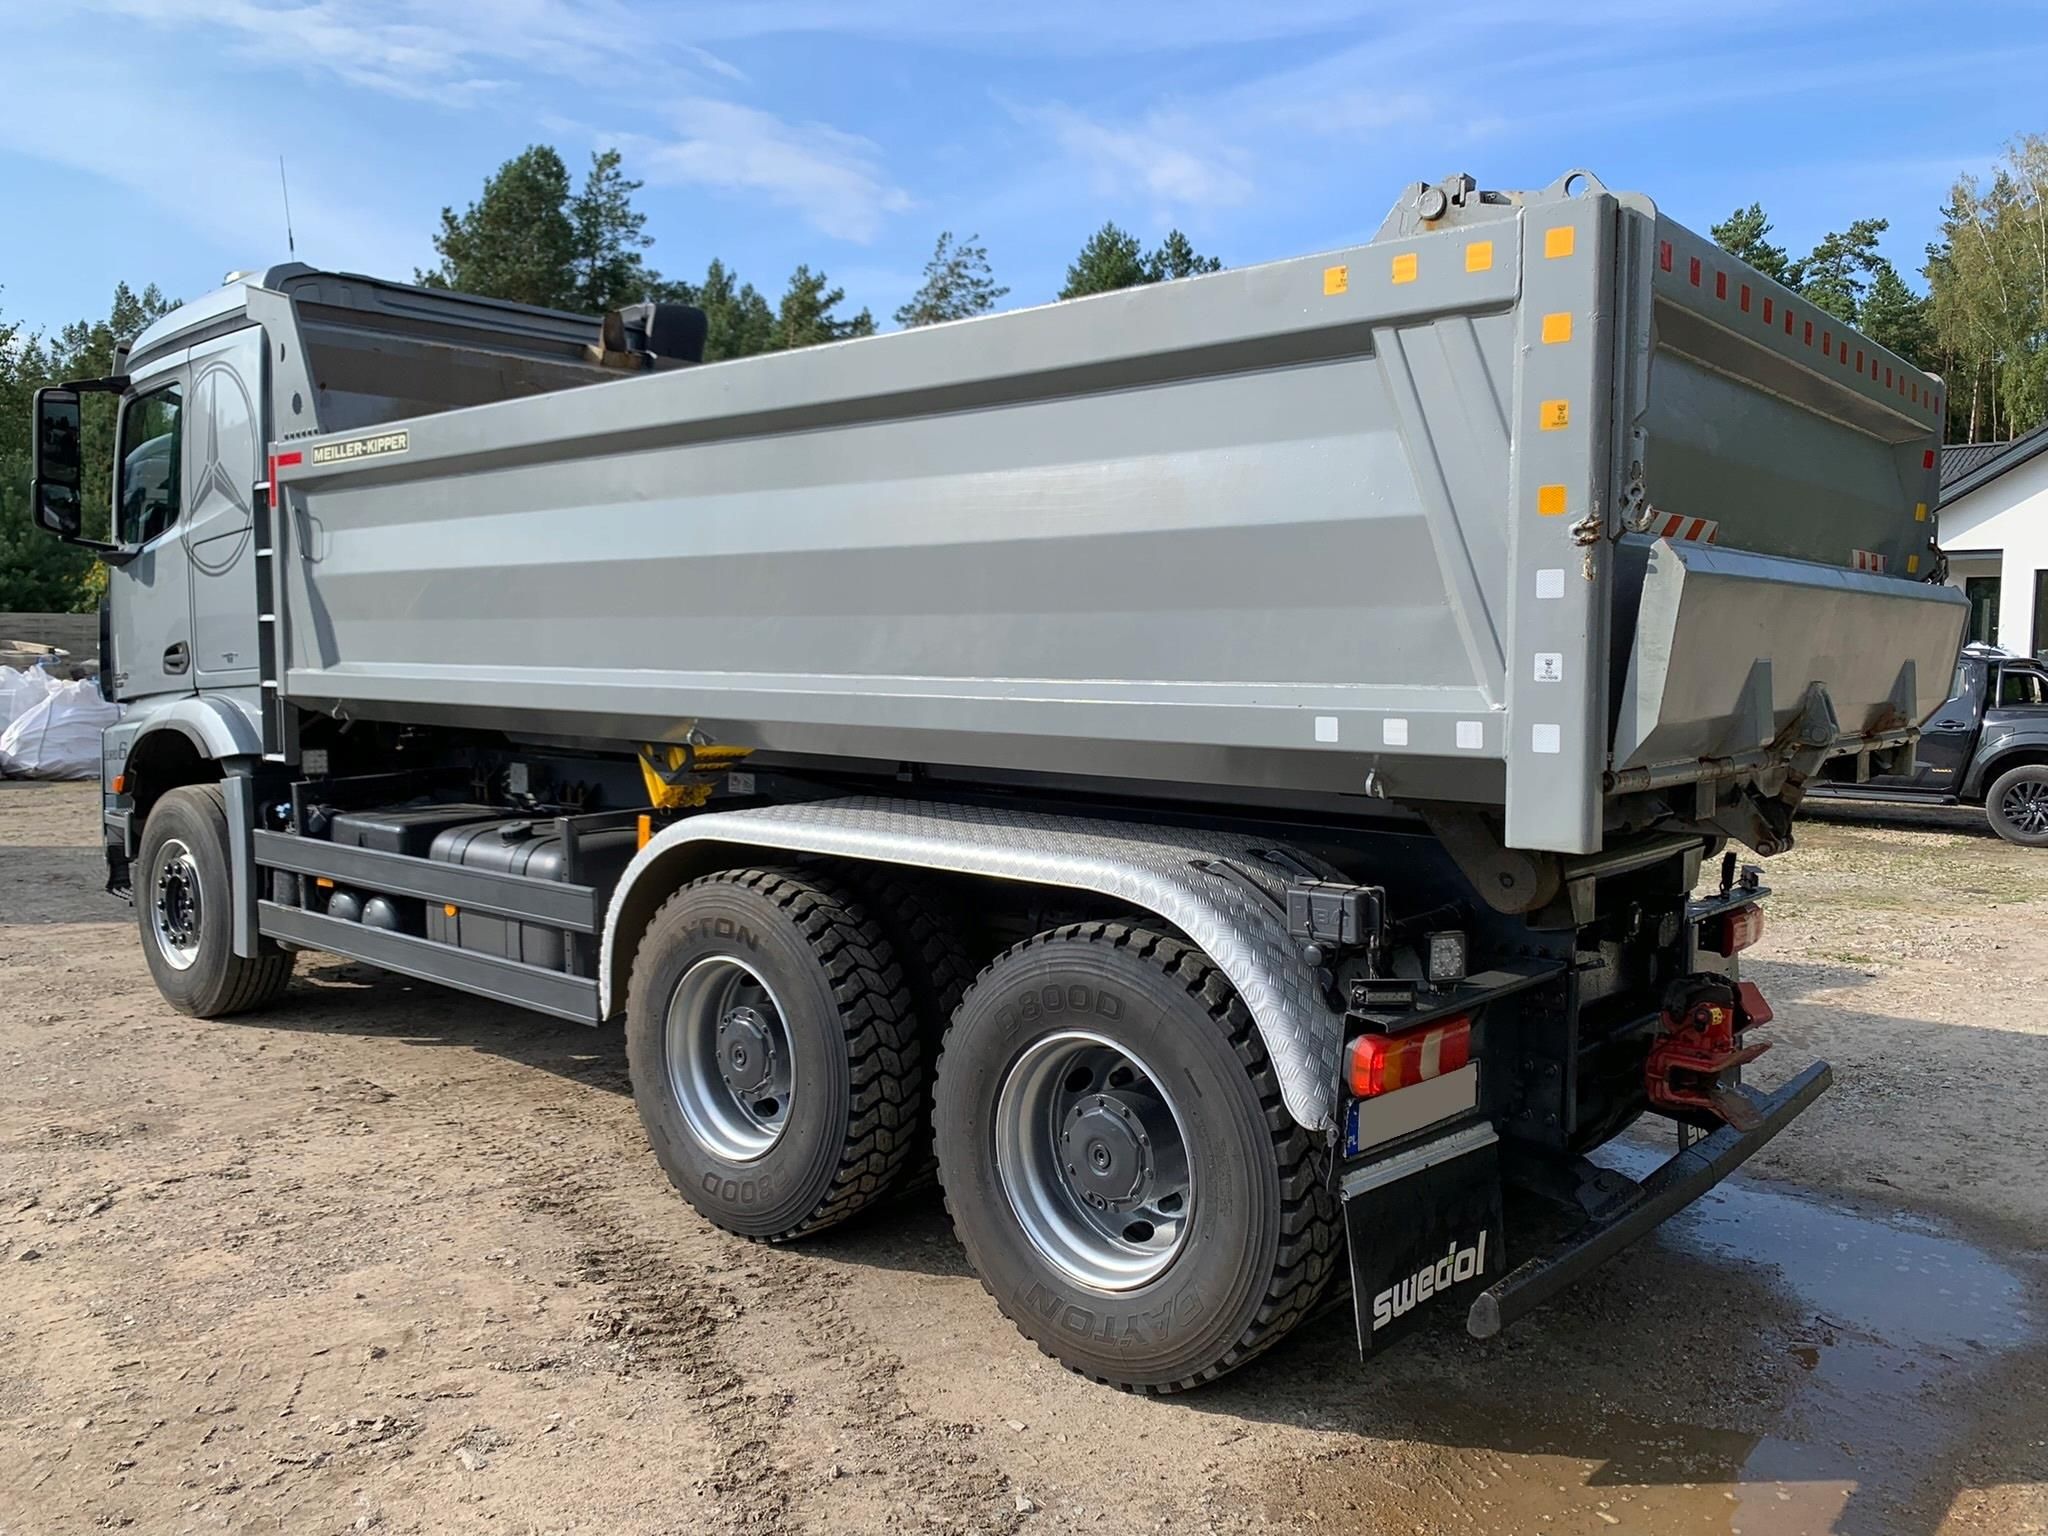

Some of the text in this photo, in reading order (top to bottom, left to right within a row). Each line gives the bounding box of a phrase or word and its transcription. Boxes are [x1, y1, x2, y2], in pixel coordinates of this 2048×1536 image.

[314, 434, 407, 462] MEILLER-KIPPER
[994, 984, 1126, 1041] D800D
[1373, 1229, 1487, 1331] swedol
[1022, 1278, 1204, 1347] DAYTON
